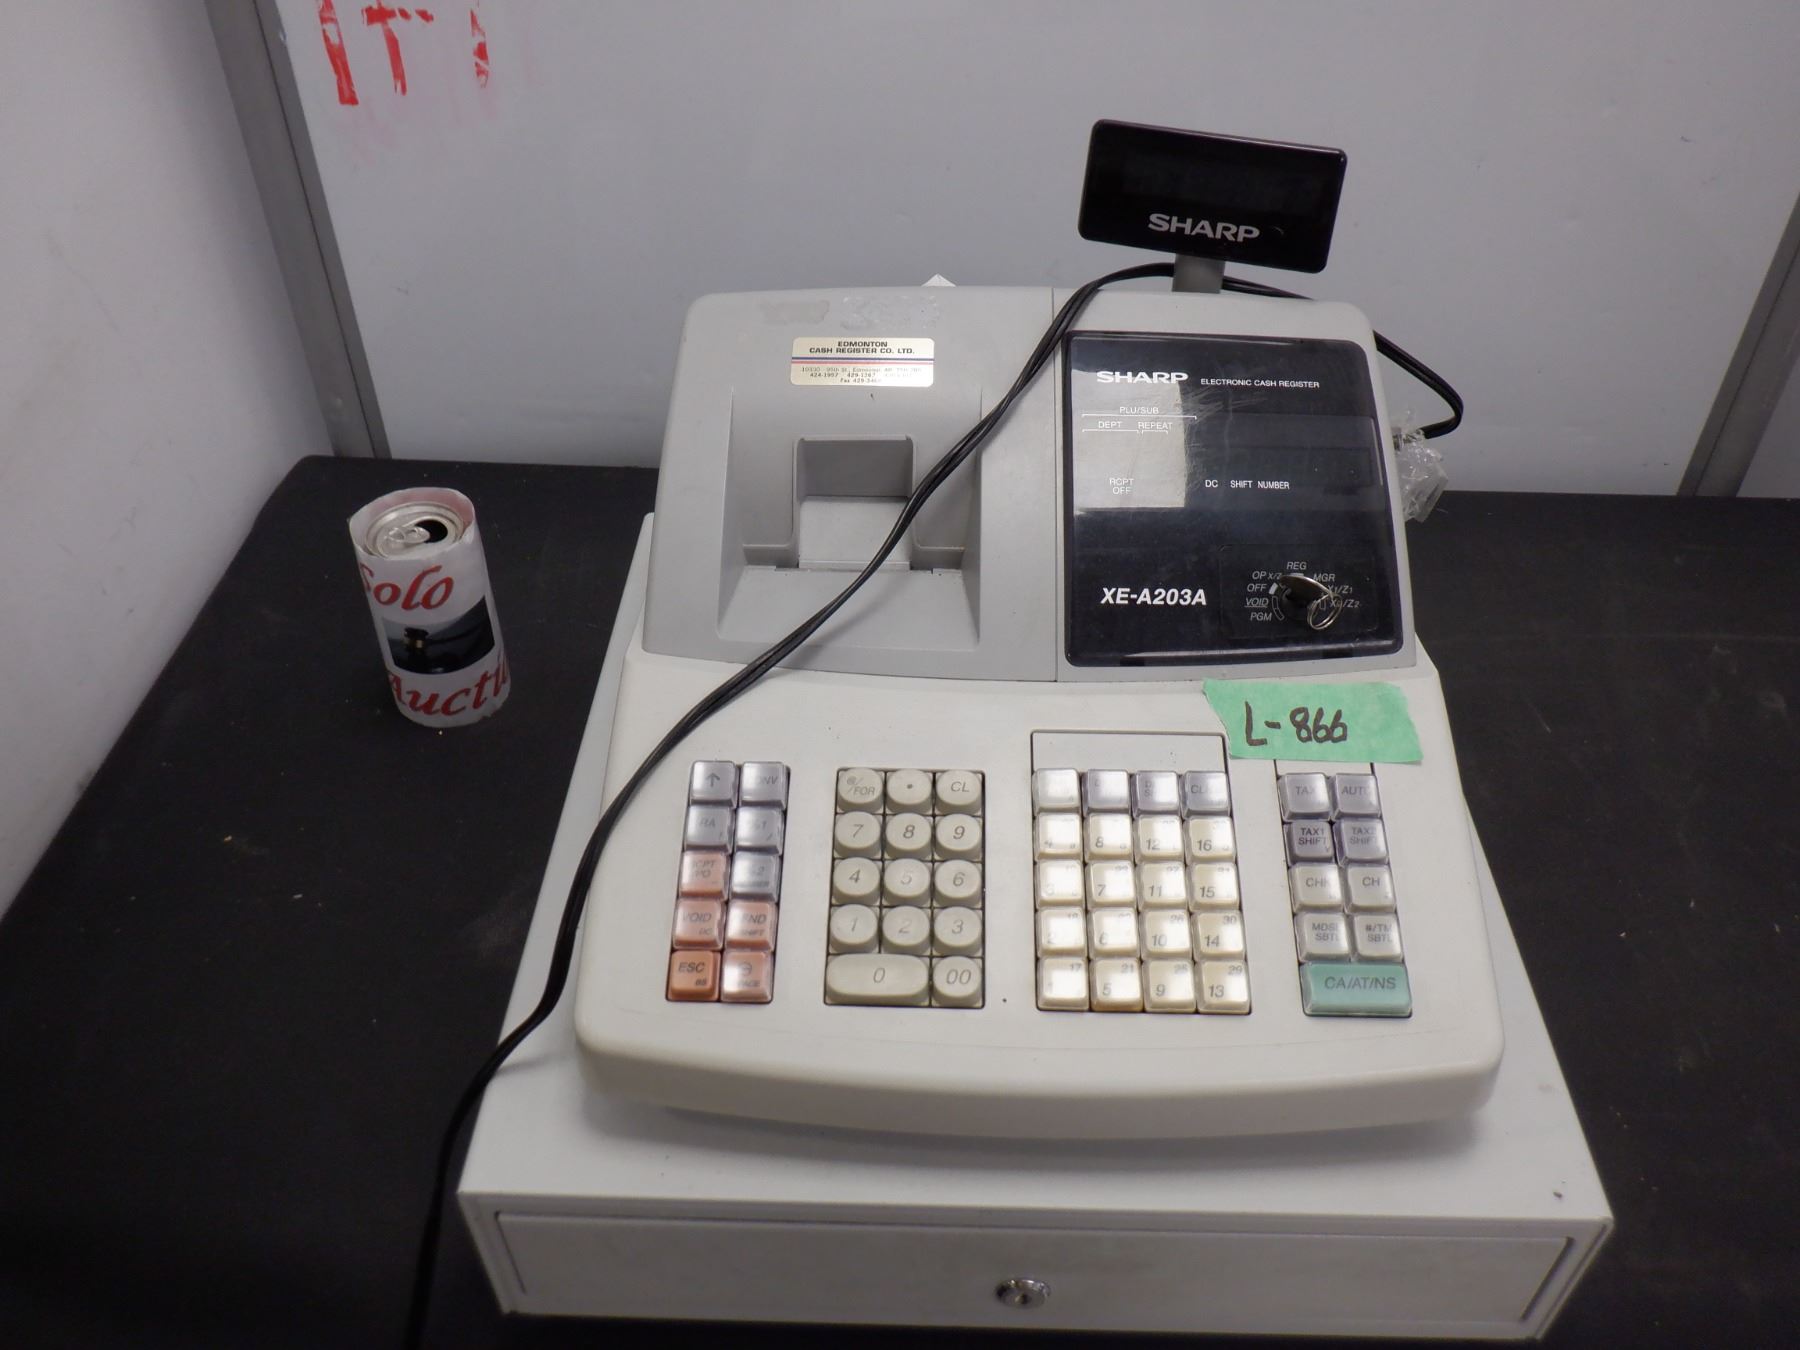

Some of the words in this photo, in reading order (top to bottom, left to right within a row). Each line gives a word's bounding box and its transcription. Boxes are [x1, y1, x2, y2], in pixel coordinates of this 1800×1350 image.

[1148, 213, 1260, 242] SHARP
[1096, 371, 1189, 384] SHARP
[1200, 378, 1252, 387] ELECTRONIC
[1254, 379, 1277, 387] CASH
[1278, 380, 1320, 388] REGISTER
[1119, 406, 1159, 415] PLU/SUB
[1098, 421, 1122, 429] DEPT
[1138, 421, 1173, 430] REPEAT
[1110, 478, 1134, 486] RCPT
[1205, 479, 1218, 488] DC
[1230, 480, 1253, 489] SHIFT
[1257, 481, 1290, 490] NUMBER
[1112, 486, 1132, 495] OFF
[1286, 562, 1307, 570] REG
[1252, 571, 1266, 580] OP
[1312, 573, 1336, 582] MGR
[1246, 583, 1267, 592] OFF
[1100, 587, 1207, 606] XE-A203A
[1245, 597, 1269, 606] VOID
[1250, 612, 1272, 621] PGM
[1245, 701, 1348, 746] L-866
[950, 781, 970, 793] CL
[851, 824, 864, 838] 7
[903, 824, 915, 839] 8
[952, 825, 965, 839] 9
[1095, 836, 1104, 848] 8
[1146, 838, 1160, 850] 12
[1197, 839, 1212, 851] 16
[1298, 836, 1327, 846] SHIFT
[849, 869, 861, 883] 4
[901, 871, 913, 885] 5
[953, 872, 966, 886] 6
[1097, 884, 1106, 897] 7
[1149, 885, 1162, 897] 11
[1200, 886, 1215, 898] 15
[851, 917, 858, 932] 1
[898, 919, 912, 934] 2
[951, 919, 964, 934] 3
[1151, 934, 1166, 946] 10
[1204, 935, 1220, 947] 14
[678, 962, 705, 973] ESC
[1228, 965, 1243, 975] 29
[873, 967, 886, 983] 0
[946, 969, 972, 985] 00
[1103, 982, 1112, 996] 5
[1324, 976, 1397, 990] CA/AT/NS
[1155, 983, 1166, 996] 9
[1208, 984, 1224, 997] 13
